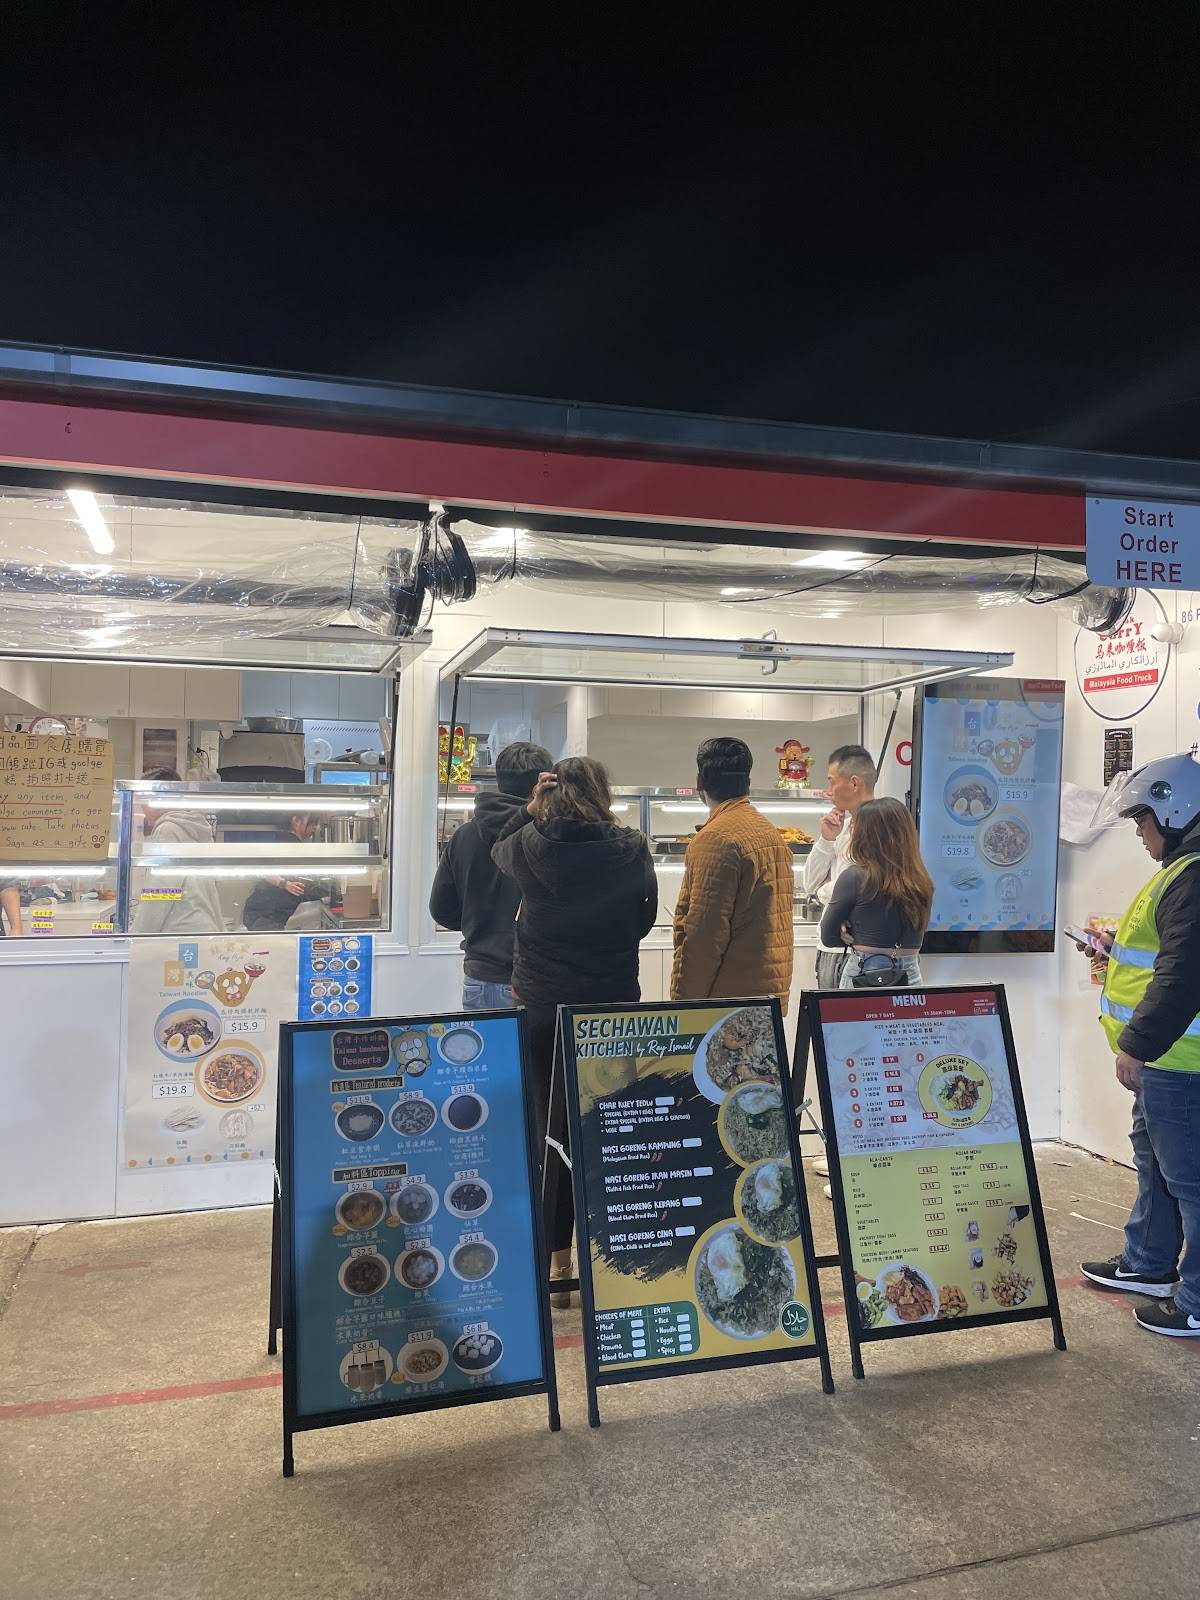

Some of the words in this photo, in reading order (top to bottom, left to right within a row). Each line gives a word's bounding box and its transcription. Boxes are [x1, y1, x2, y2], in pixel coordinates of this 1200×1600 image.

[1124, 507, 1173, 527] Start
[1120, 533, 1178, 554] Order
[1116, 560, 1182, 583] HERE
[1181, 610, 1193, 623] 86
[1089, 677, 1115, 688] Malaysia
[1116, 675, 1133, 685] Food
[1134, 673, 1153, 683] Truck
[1006, 790, 1028, 801] $15.9
[71, 807, 81, 816] to
[946, 847, 970, 857] $19.8
[183, 950, 194, 962] 台
[892, 994, 927, 1007] MENU
[231, 1022, 258, 1033] $15.9
[577, 1016, 680, 1040] SECHAWAN
[576, 1041, 634, 1059] KITCHEN
[636, 1042, 645, 1057] by
[668, 1037, 695, 1052] Ismail
[936, 1057, 957, 1068] DELUXE
[958, 1057, 969, 1067] SET
[159, 1086, 187, 1097] $19.8
[349, 1095, 370, 1104] $11.9
[636, 1099, 654, 1108] TEOW
[601, 1145, 619, 1155] NASI
[620, 1143, 647, 1153] GORENG
[648, 1141, 682, 1151] KAMPUNG
[406, 1176, 422, 1184] $4.9
[459, 1170, 475, 1179] $3.9
[605, 1176, 622, 1185] NASI
[622, 1173, 650, 1183] GORENG
[651, 1172, 669, 1181] IKAN
[670, 1170, 693, 1180] MASIN
[607, 1205, 624, 1214] NASI
[625, 1203, 653, 1212] GORENG
[653, 1199, 681, 1209] KERANG
[609, 1235, 627, 1244] NASI
[627, 1232, 656, 1243] GORENG
[595, 1312, 619, 1322] CHOICES
[619, 1311, 626, 1319] OF
[627, 1309, 643, 1318] MEAT
[653, 1306, 671, 1315] EXTRA
[783, 1309, 807, 1326] حلال
[466, 1324, 483, 1333] $6.8
[599, 1323, 615, 1331] Meat
[410, 1332, 432, 1341] $11.9
[600, 1333, 622, 1341] Chicken
[661, 1346, 676, 1355] Spicy
[601, 1353, 617, 1361] Blood
